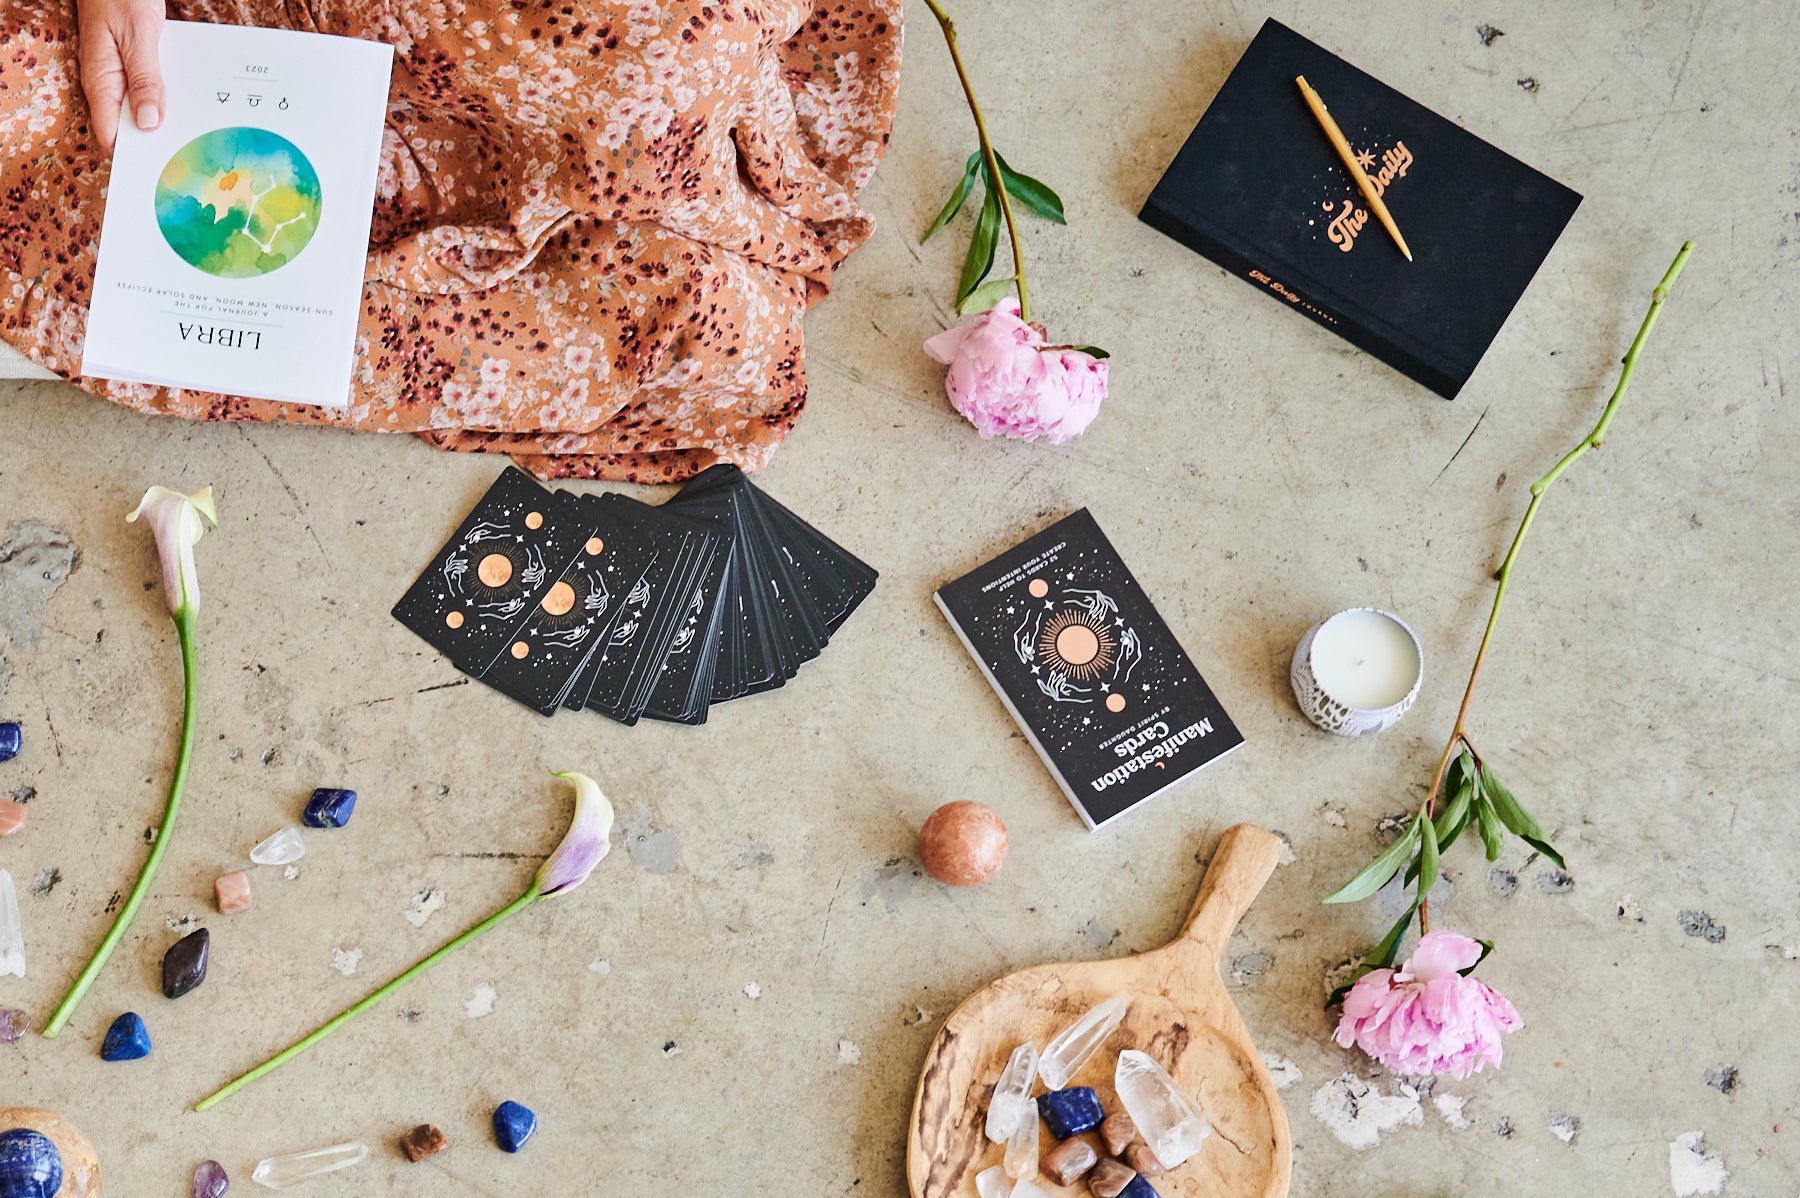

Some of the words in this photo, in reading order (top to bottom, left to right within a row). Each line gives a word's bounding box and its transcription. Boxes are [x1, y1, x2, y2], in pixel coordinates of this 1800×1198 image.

[245, 65, 269, 73] 2023
[1327, 200, 1368, 252] The
[116, 281, 152, 293] ECLIPSE
[1249, 270, 1271, 284] The
[1269, 282, 1300, 303] Daily
[156, 289, 185, 298] SOLAR
[189, 294, 209, 302] AND
[174, 301, 192, 309] THE
[195, 303, 213, 312] FOR
[247, 301, 268, 309] NEW
[217, 307, 258, 317] JOURNAL
[315, 308, 334, 316] SUN
[178, 322, 262, 350] LIBRA
[1041, 541, 1066, 559] CREATE
[1022, 557, 1040, 570] YOUR
[1026, 560, 1049, 575] CARDS
[981, 567, 1021, 593] INTENTIONS
[1016, 573, 1026, 582] TO
[999, 579, 1015, 592] HELP
[1161, 706, 1170, 715] BY
[1137, 712, 1159, 729] SPIRIT
[1098, 725, 1136, 750] DAUGHTER
[1114, 721, 1169, 758] Cards
[1090, 717, 1214, 792] Manifestation
